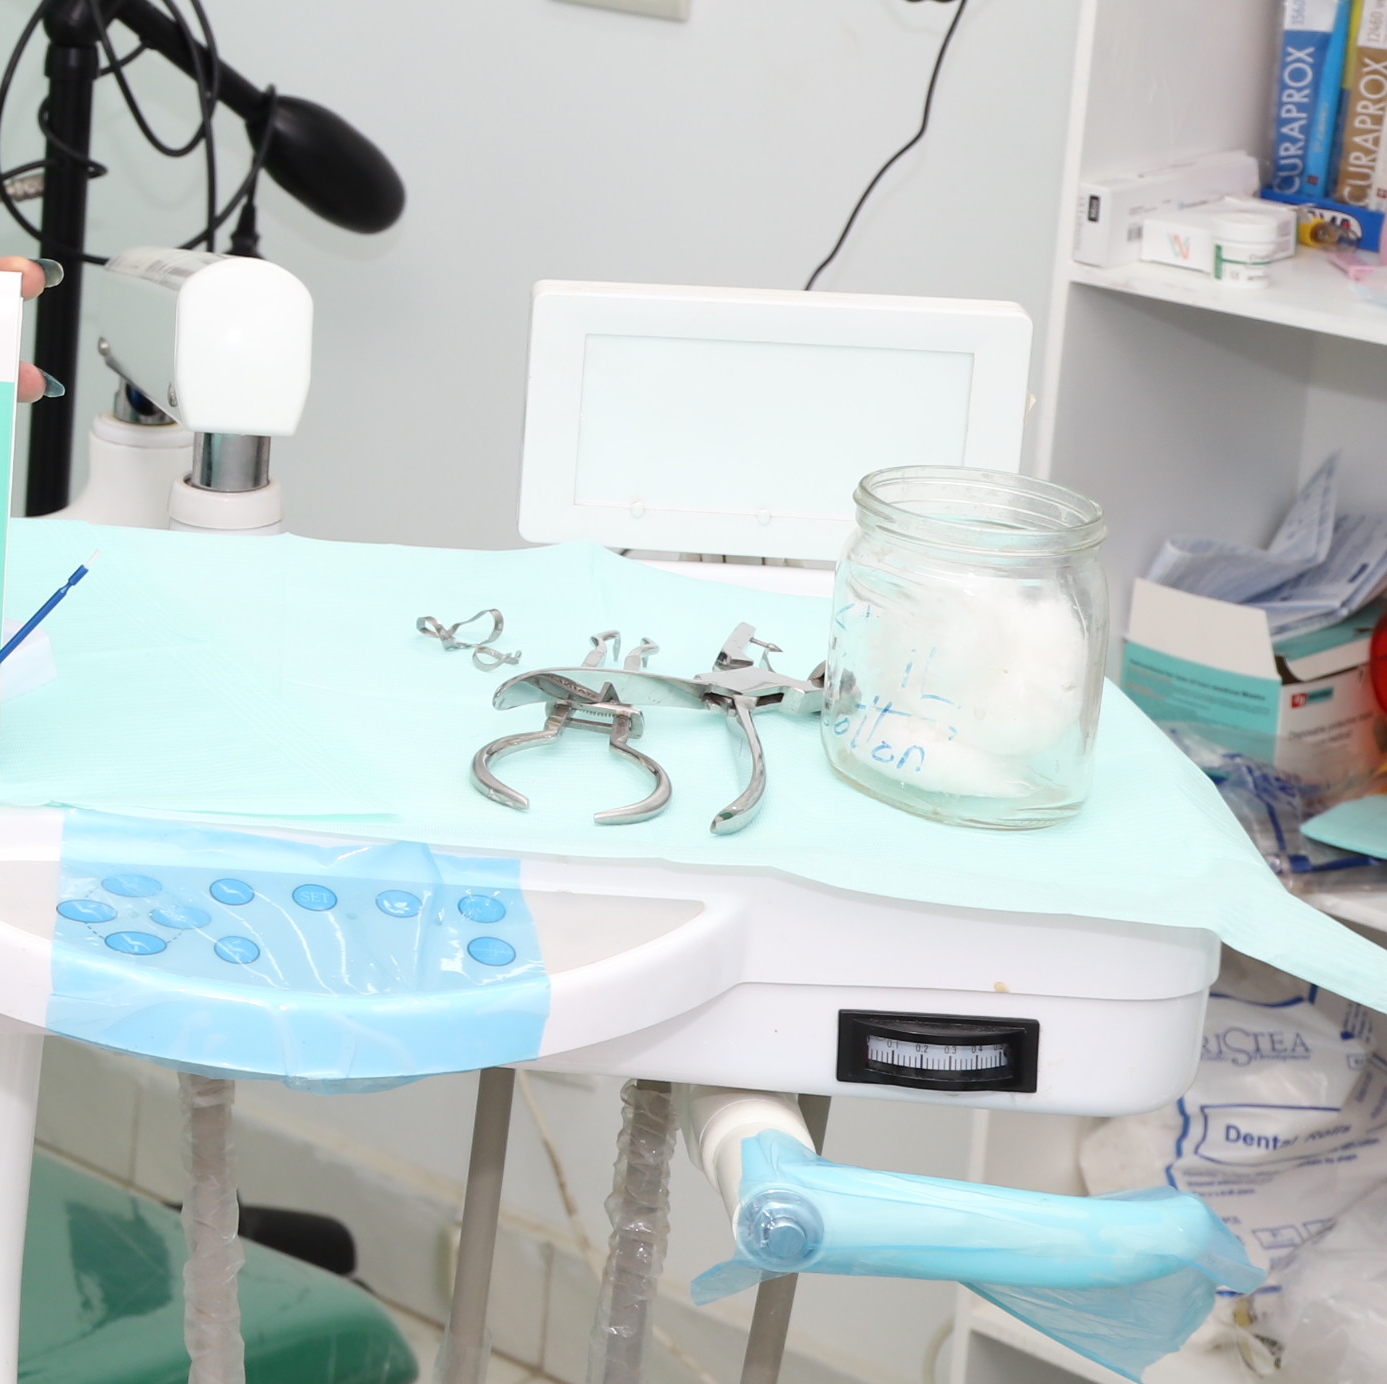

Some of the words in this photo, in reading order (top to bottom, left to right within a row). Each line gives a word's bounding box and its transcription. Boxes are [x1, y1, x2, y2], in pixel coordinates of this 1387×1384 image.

[1274, 46, 1315, 195] CURAPROX
[1343, 57, 1387, 206] CURAPROX
[887, 1040, 899, 1049] 0.1
[916, 1044, 928, 1053] 0.2
[944, 1046, 957, 1054] 0.3
